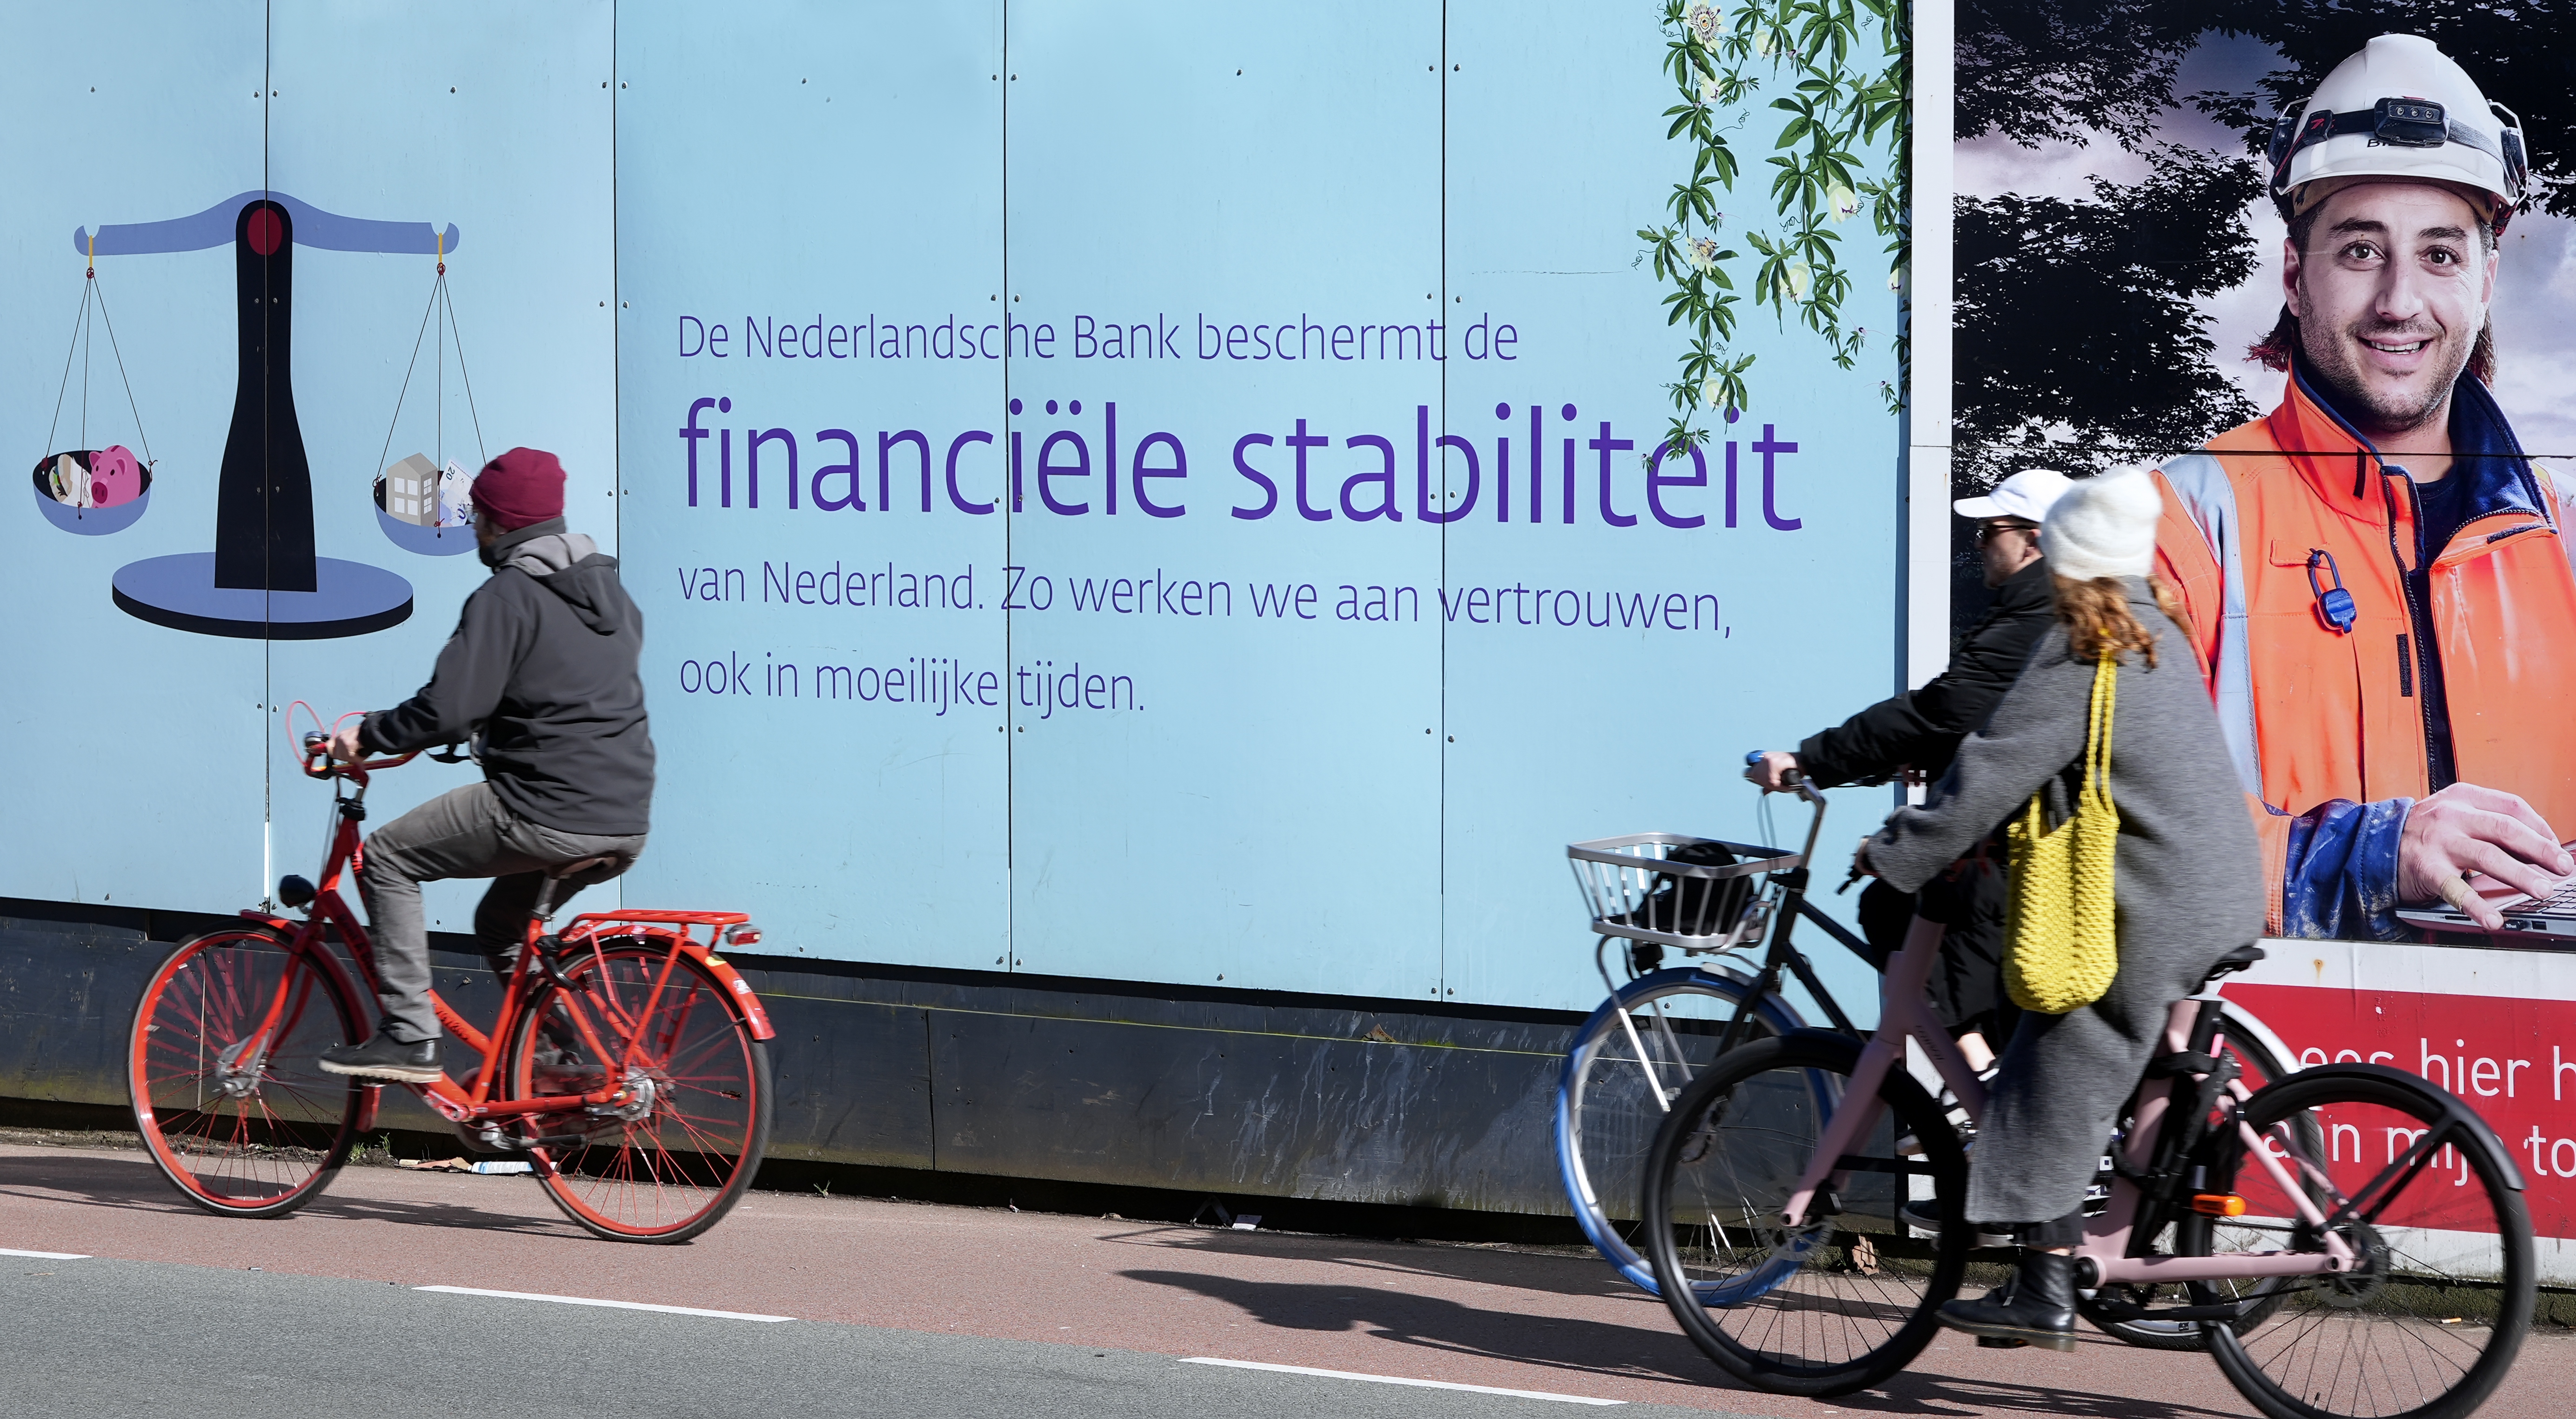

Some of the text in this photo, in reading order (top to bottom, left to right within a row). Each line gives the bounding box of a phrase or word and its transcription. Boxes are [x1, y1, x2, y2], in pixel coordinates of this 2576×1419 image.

[679, 312, 1518, 360] De Nederlandsche Bank beschermt de
[446, 466, 455, 480] 20
[679, 396, 1803, 531] financiële stabiliteit
[678, 560, 1730, 639] van Nederland. Zo werken we aan vertrouwen,
[680, 651, 1145, 719] ook in moeilijke tijden.
[2421, 1038, 2531, 1098] hier
[2263, 1120, 2360, 1163] an
